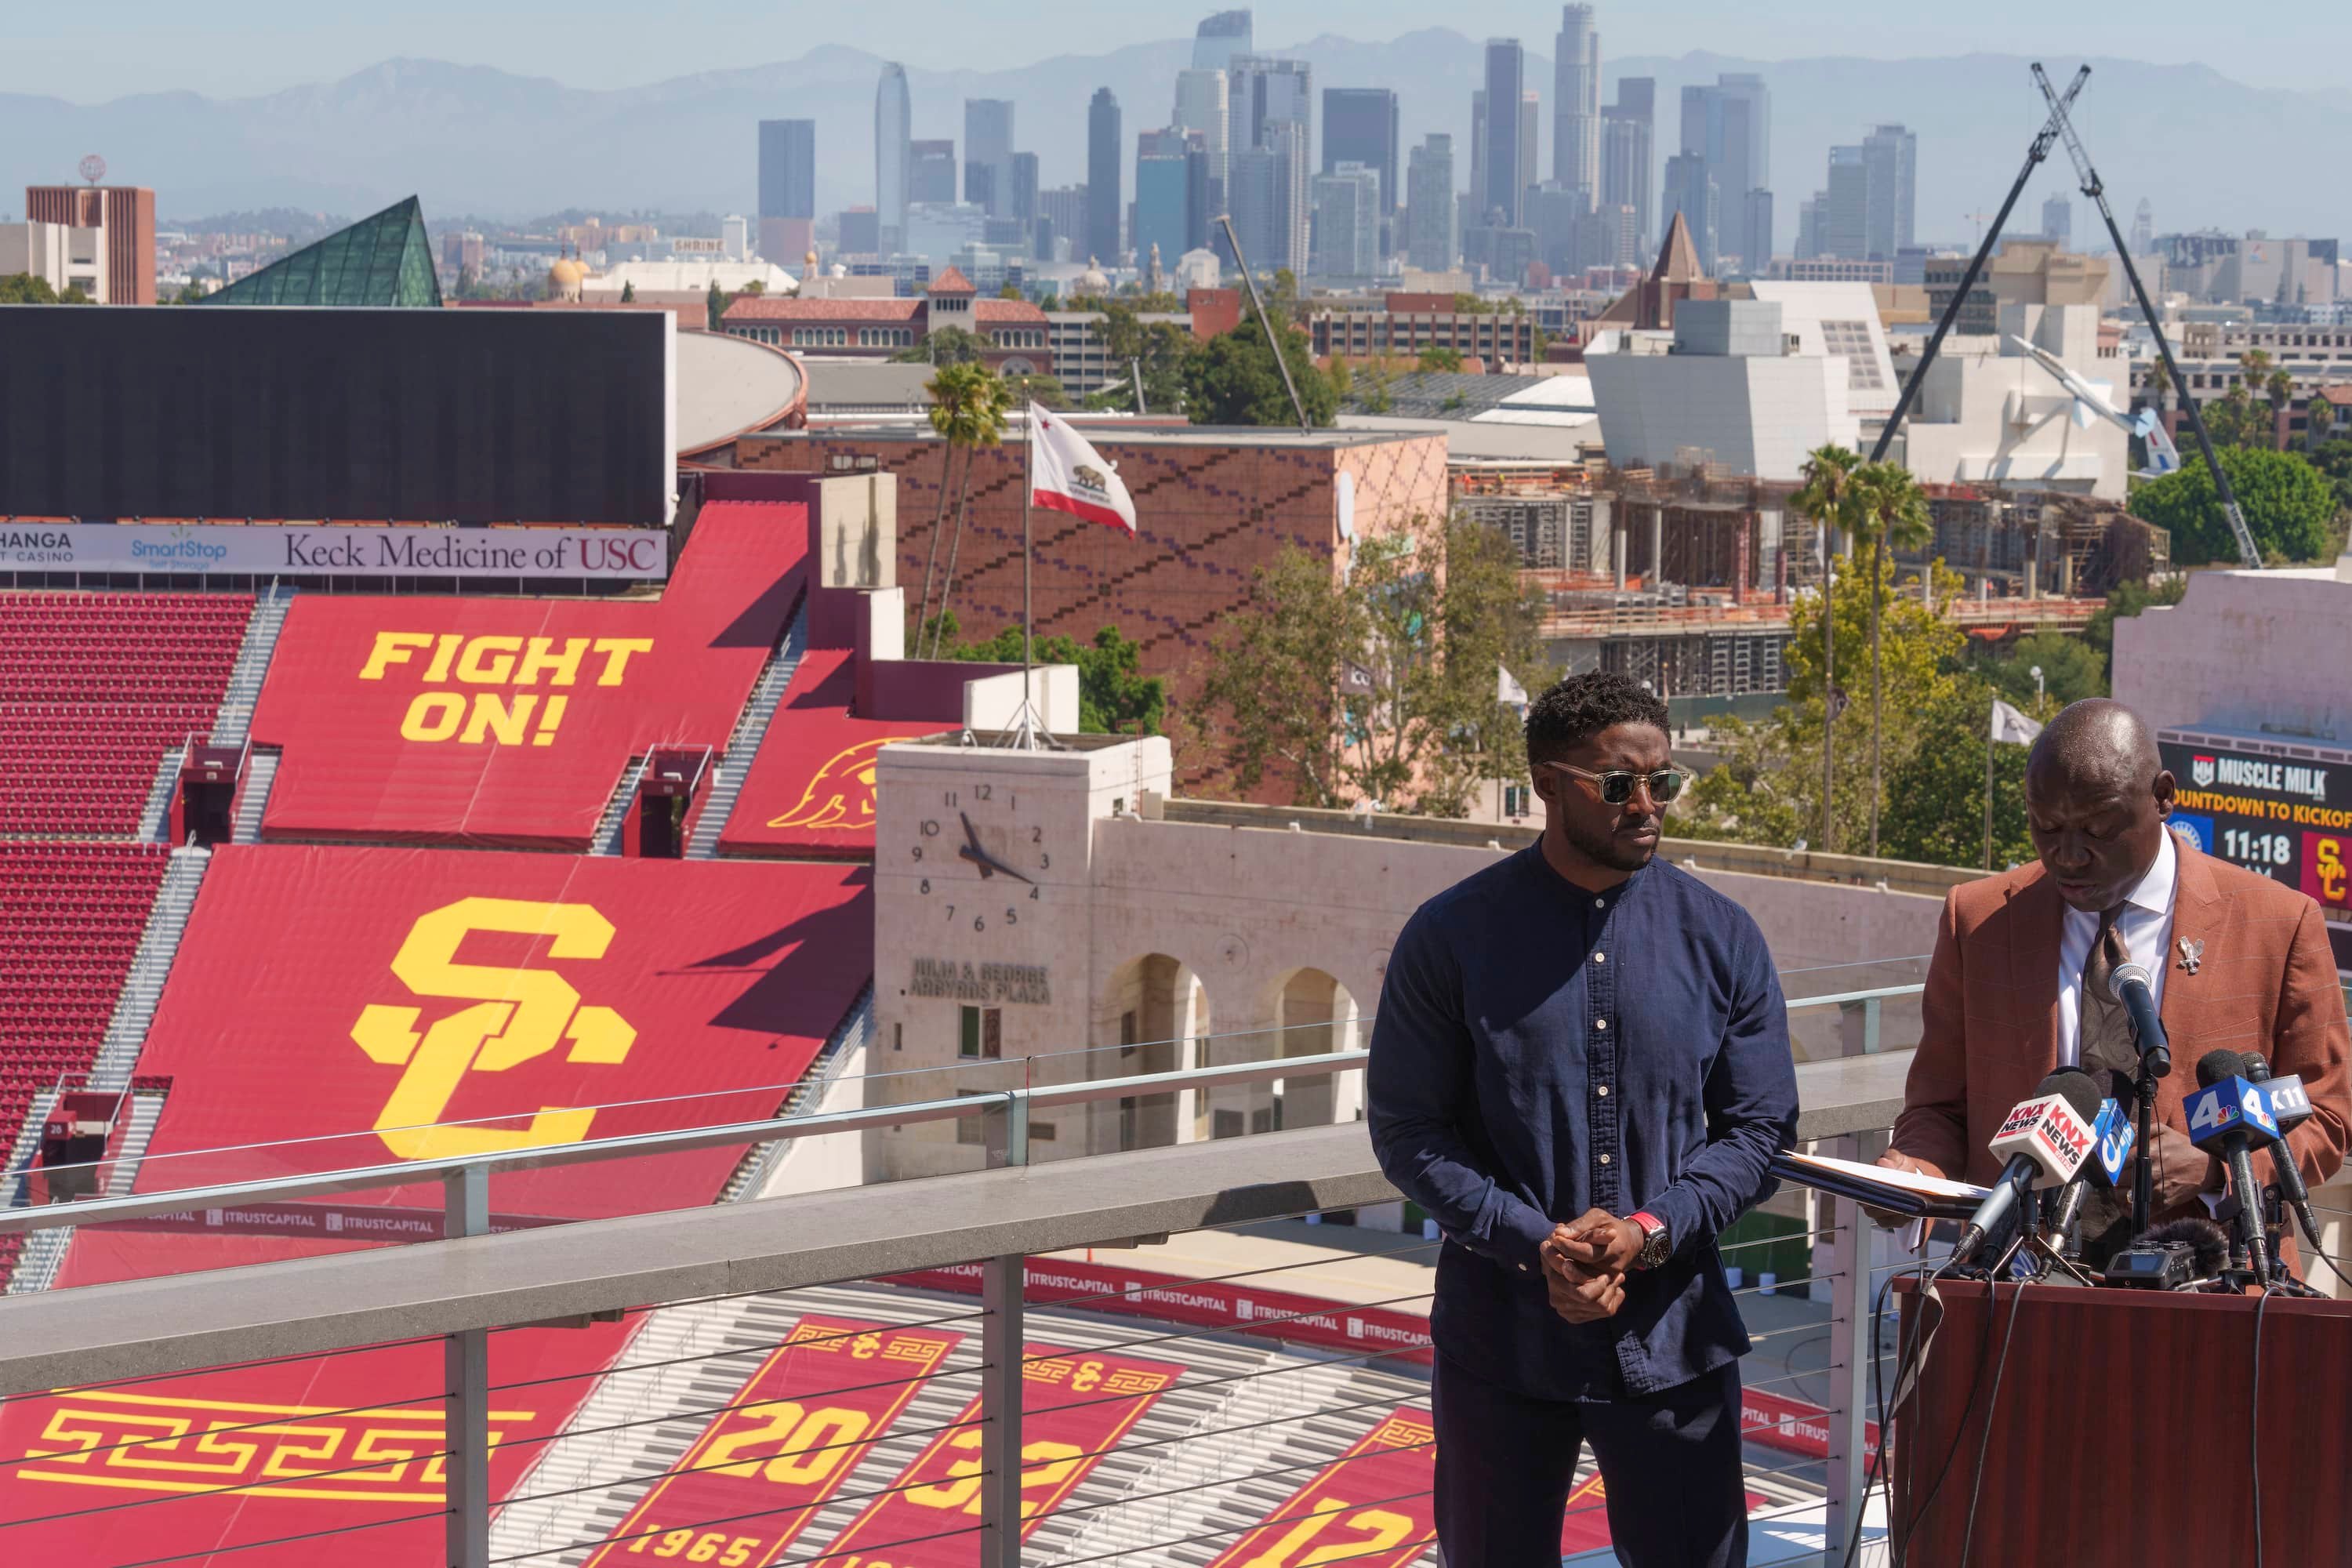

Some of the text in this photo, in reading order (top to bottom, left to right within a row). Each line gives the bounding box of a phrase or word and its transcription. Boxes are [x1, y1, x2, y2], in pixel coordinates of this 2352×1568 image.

[675, 239, 724, 251] SHRINE
[16, 551, 74, 562] CASINO
[132, 540, 227, 561] SmartStop
[285, 534, 657, 571] Keck Medicine of USC
[358, 631, 654, 686] FIGHT
[400, 691, 568, 746] ON!
[2218, 758, 2326, 797] MUSCLE MILK
[945, 793, 957, 808] 11
[975, 785, 992, 800] 12
[2175, 790, 2264, 817] OUNTDOWN
[2267, 801, 2290, 820] TO
[920, 820, 939, 837] 10
[1032, 827, 1042, 843] 2
[912, 847, 923, 862] 9
[2225, 829, 2290, 865] 11:18
[1040, 853, 1050, 869] 3
[920, 879, 931, 895] 8
[1029, 885, 1039, 901] 4
[946, 906, 956, 921] 7
[1006, 908, 1017, 924] 5
[974, 916, 985, 932] 6
[995, 982, 1051, 1005] PLAZA
[2009, 1102, 2051, 1121] KNX
[2190, 1090, 2220, 1130] 4
[2242, 1087, 2265, 1123] 4
[2000, 1116, 2042, 1132] NEWS
[2049, 1105, 2090, 1156] KNX
[2042, 1119, 2081, 1166] NEWS
[225, 1212, 316, 1226] ITRUSTCAPITAL
[345, 1216, 433, 1232] ITRUSTCAPITAL
[1030, 1272, 1114, 1294] ITRUSTCAPITAL
[1144, 1290, 1227, 1312] ITRUSTCAPITAL
[691, 1398, 871, 1486] 20
[1240, 1497, 1414, 1568] 12
[628, 1523, 761, 1567] 1965
